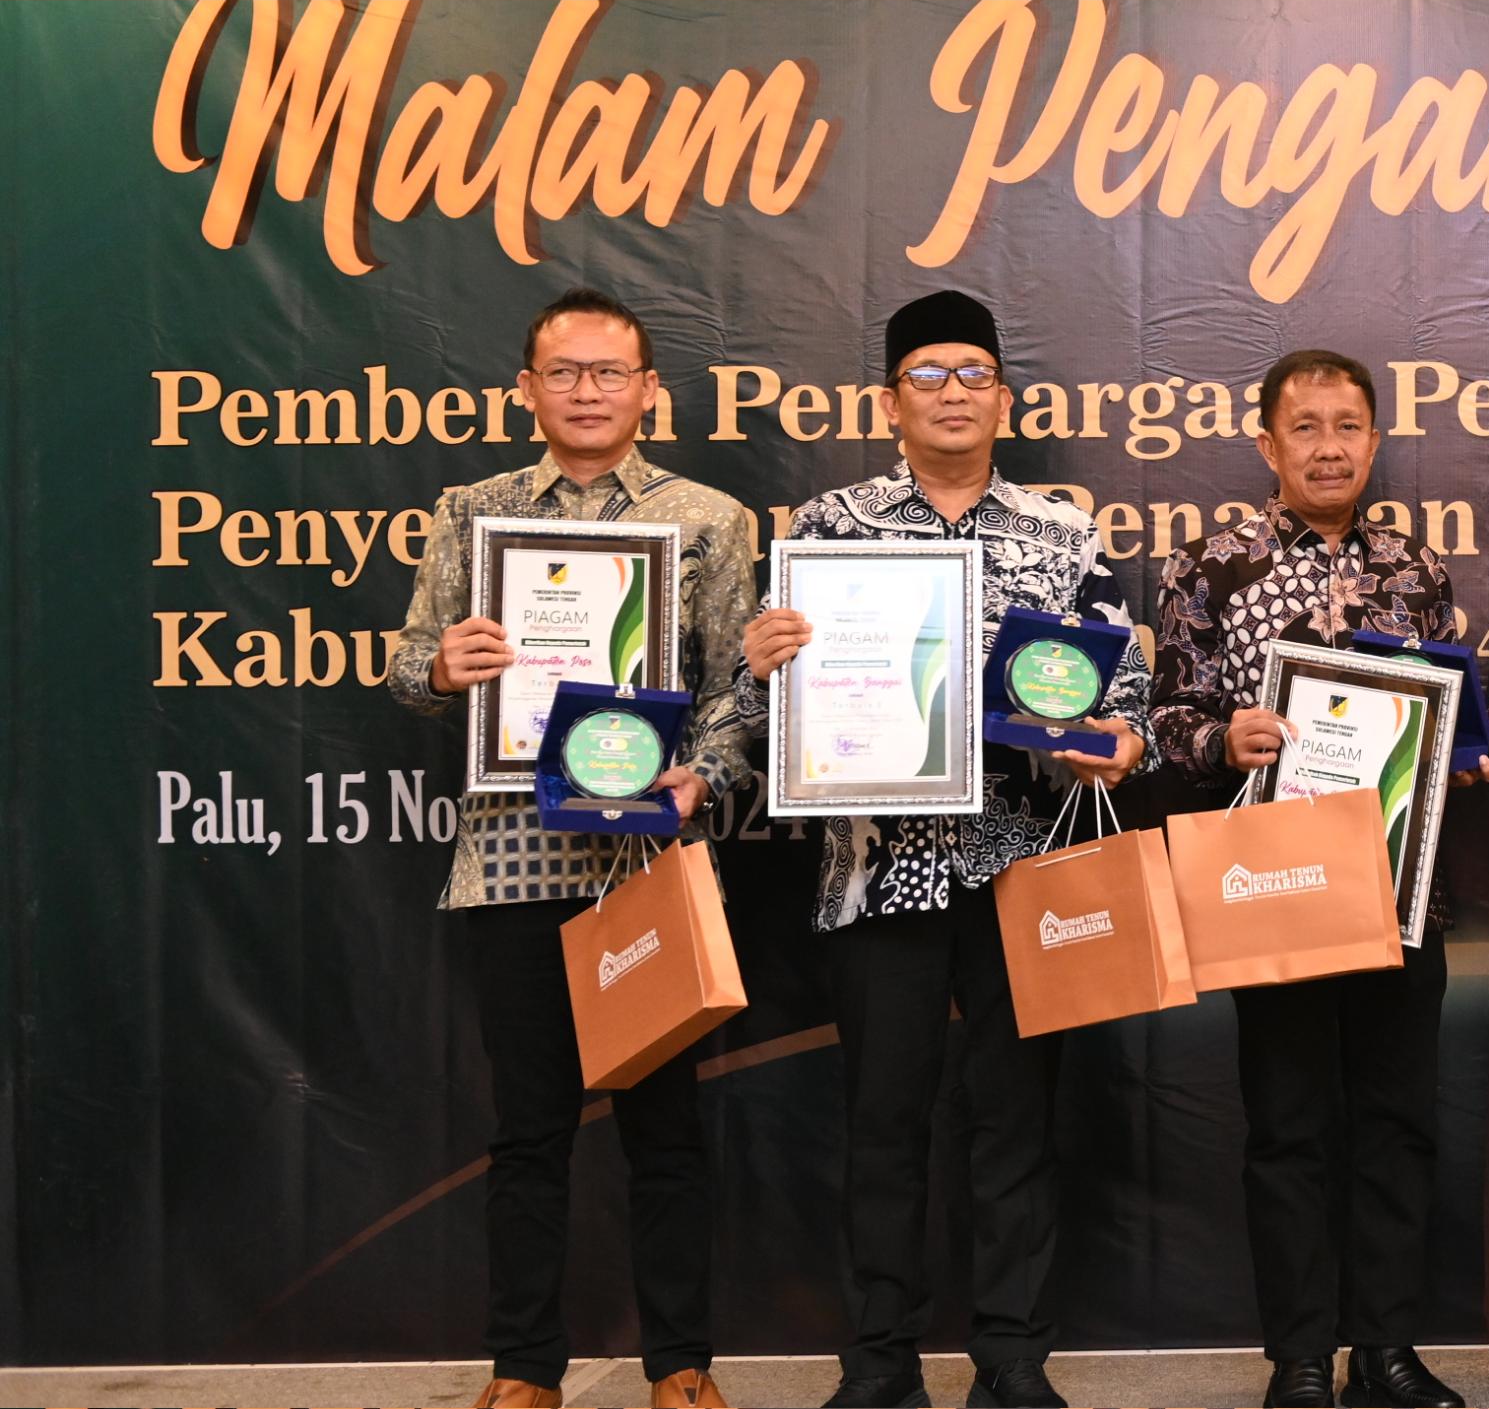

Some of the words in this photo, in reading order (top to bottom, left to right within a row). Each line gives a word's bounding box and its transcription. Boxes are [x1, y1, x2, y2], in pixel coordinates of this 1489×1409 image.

[153, 0, 830, 276] Malam
[523, 609, 589, 625] PIAGAM
[1301, 738, 1362, 762] PIAGAM
[156, 769, 282, 857] Palu,
[304, 770, 370, 845] 15
[1252, 872, 1328, 894] KHARISMA
[1061, 918, 1114, 941] KHARISMA
